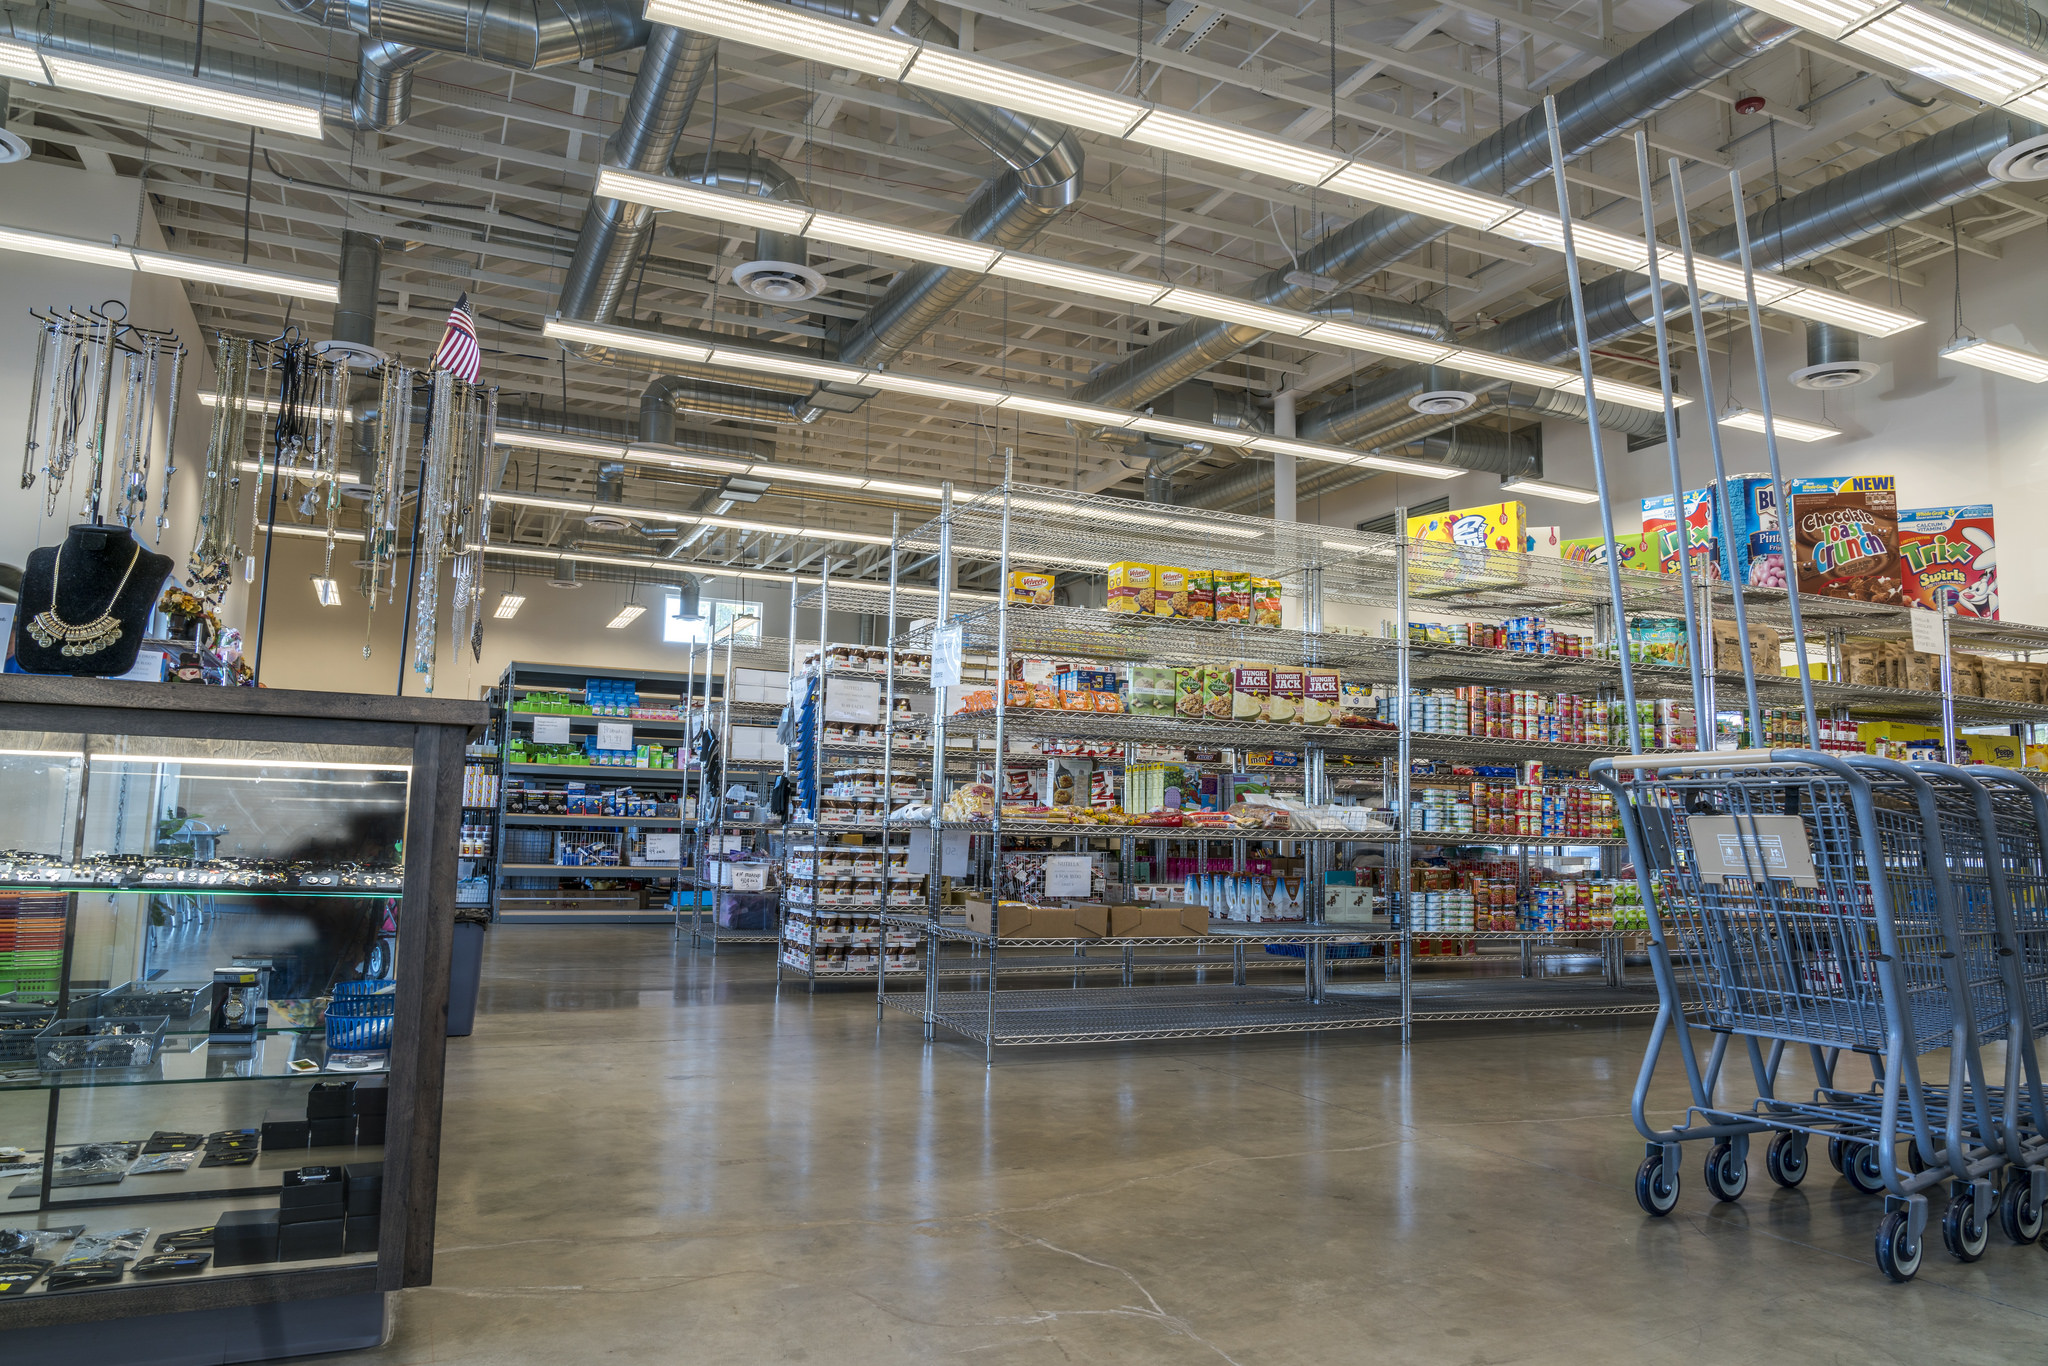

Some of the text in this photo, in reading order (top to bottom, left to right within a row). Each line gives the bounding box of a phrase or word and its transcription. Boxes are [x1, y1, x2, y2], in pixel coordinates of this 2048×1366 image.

[1852, 476, 1894, 490] NEW!
[1802, 508, 1874, 532] Chocolate
[1822, 522, 1865, 546] Toast
[1812, 532, 1887, 574] Crunch
[1899, 534, 1974, 574] Trix
[1023, 578, 1047, 586] Velveeta
[1920, 569, 1966, 587] Swirls
[1240, 677, 1268, 686] JACK
[1274, 680, 1302, 689] JACK
[1309, 682, 1336, 692] JACK
[1994, 747, 2014, 760] Peeps
